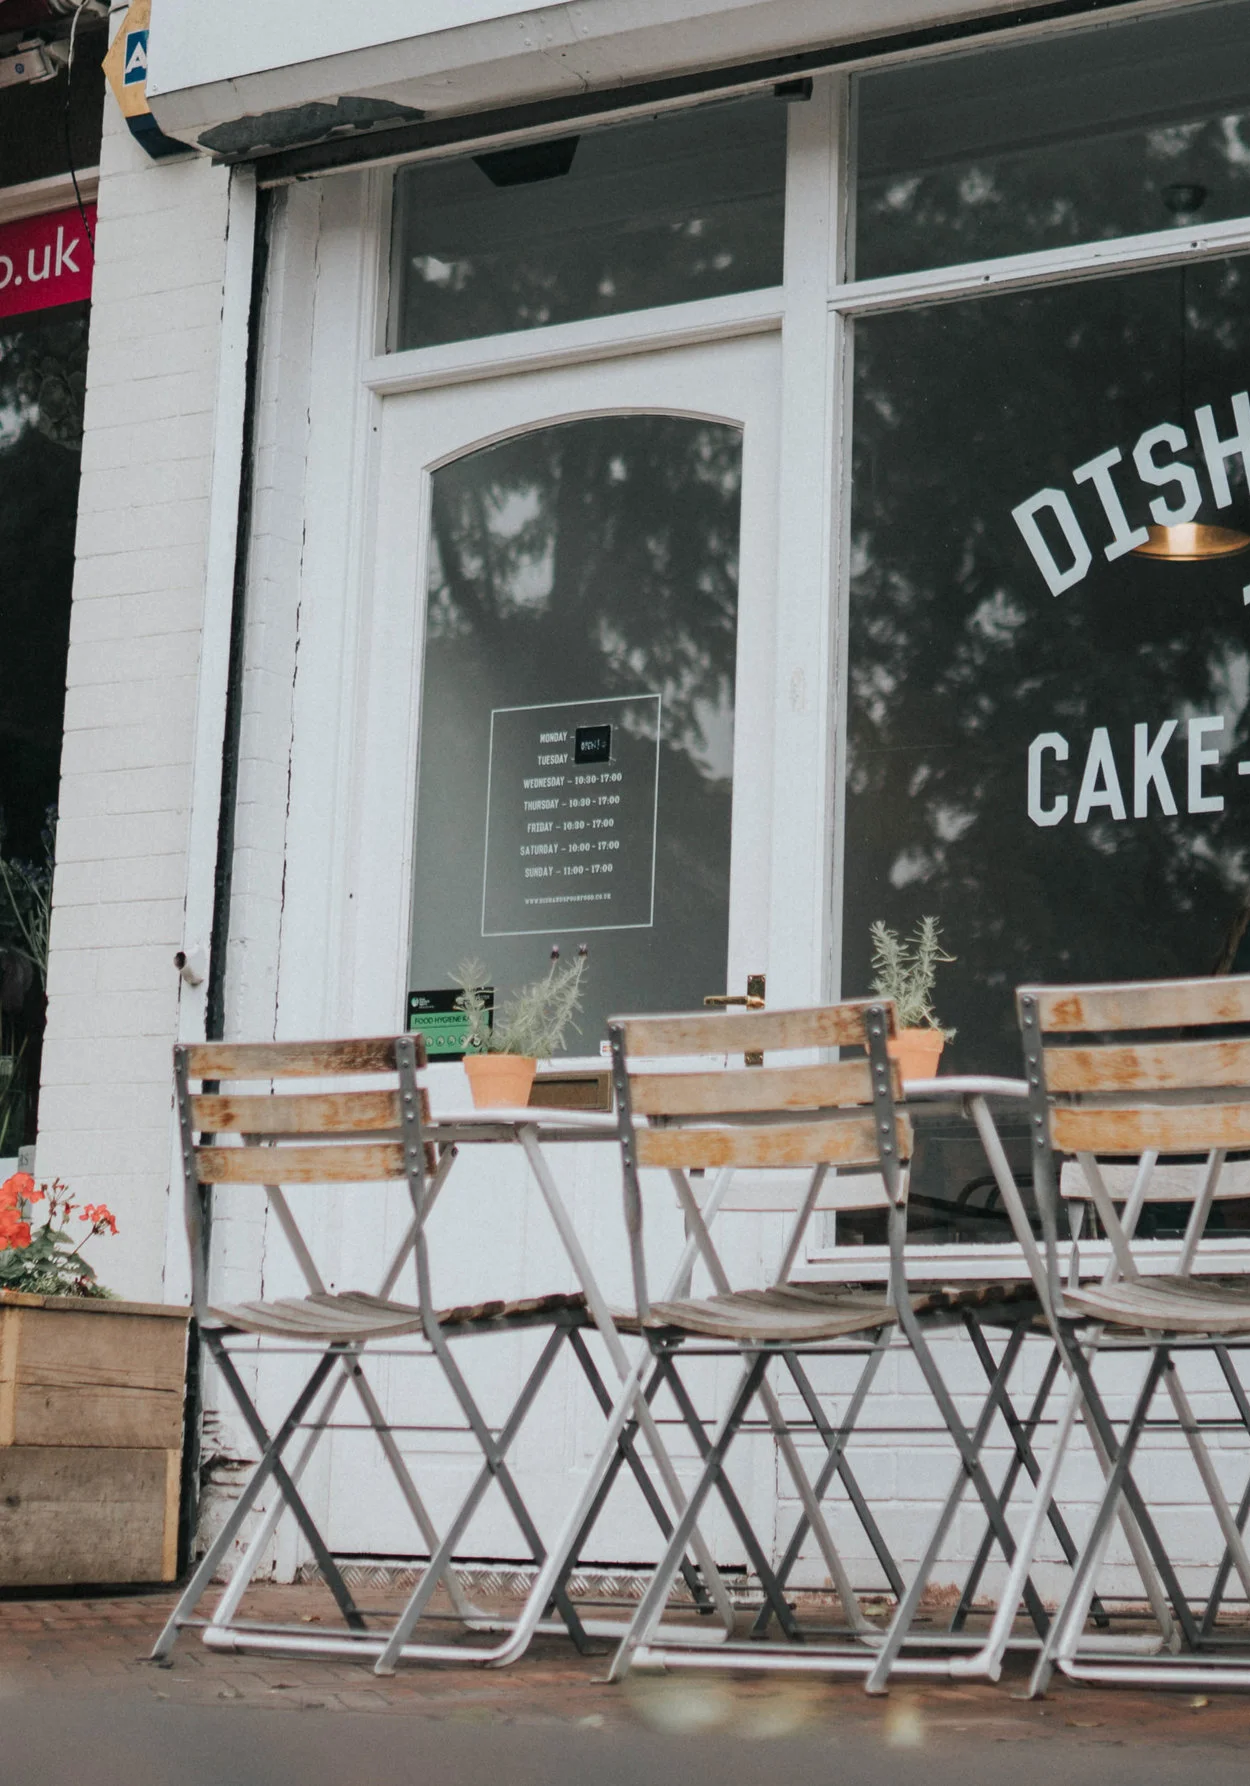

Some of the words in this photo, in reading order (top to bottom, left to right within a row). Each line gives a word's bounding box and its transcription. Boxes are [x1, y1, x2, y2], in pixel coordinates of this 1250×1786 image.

[539, 731, 568, 744] MONDAY
[537, 753, 569, 766] TUESDAY
[523, 776, 565, 789] WEDNESDAY
[524, 798, 560, 812] THURSDAY
[569, 797, 591, 808] 10:30
[598, 795, 620, 806] 17:00
[527, 822, 554, 833] FRIDAY
[563, 820, 585, 831] 10:30
[592, 818, 614, 829] 17:00
[519, 843, 559, 856] SATURDAY
[568, 842, 590, 853] 10:00
[598, 840, 620, 850] 17:00
[524, 866, 554, 878] SUNDAY
[563, 865, 584, 876] 11:00
[591, 863, 613, 874] 17:00
[414, 1017, 433, 1025] FOOD
[434, 1015, 462, 1024] HYGIENE
